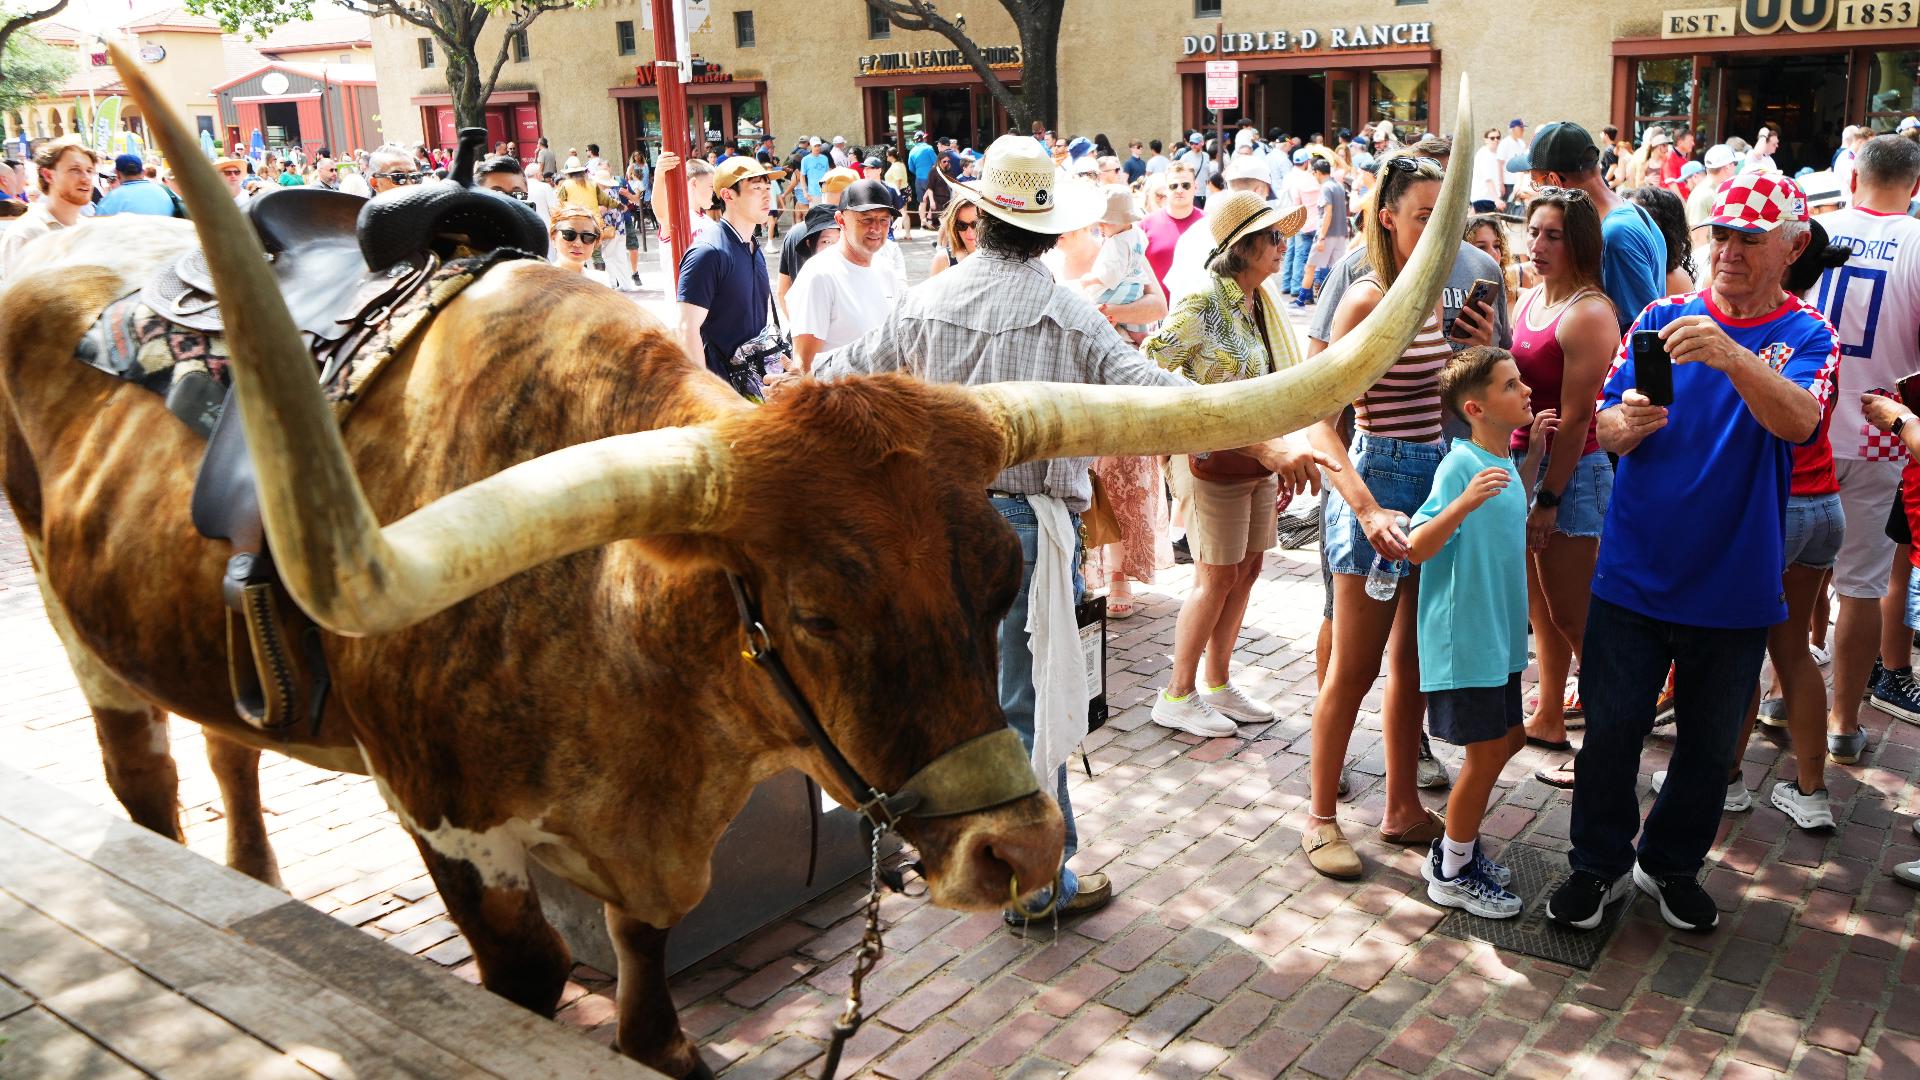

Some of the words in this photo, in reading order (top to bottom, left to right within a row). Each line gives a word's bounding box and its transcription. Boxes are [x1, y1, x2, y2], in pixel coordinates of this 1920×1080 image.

[1670, 14, 1726, 34] EST.
[1844, 2, 1912, 25] 1853
[1331, 22, 1432, 48] RANCH
[879, 53, 911, 70] WILL
[1816, 265, 1888, 359] 10
